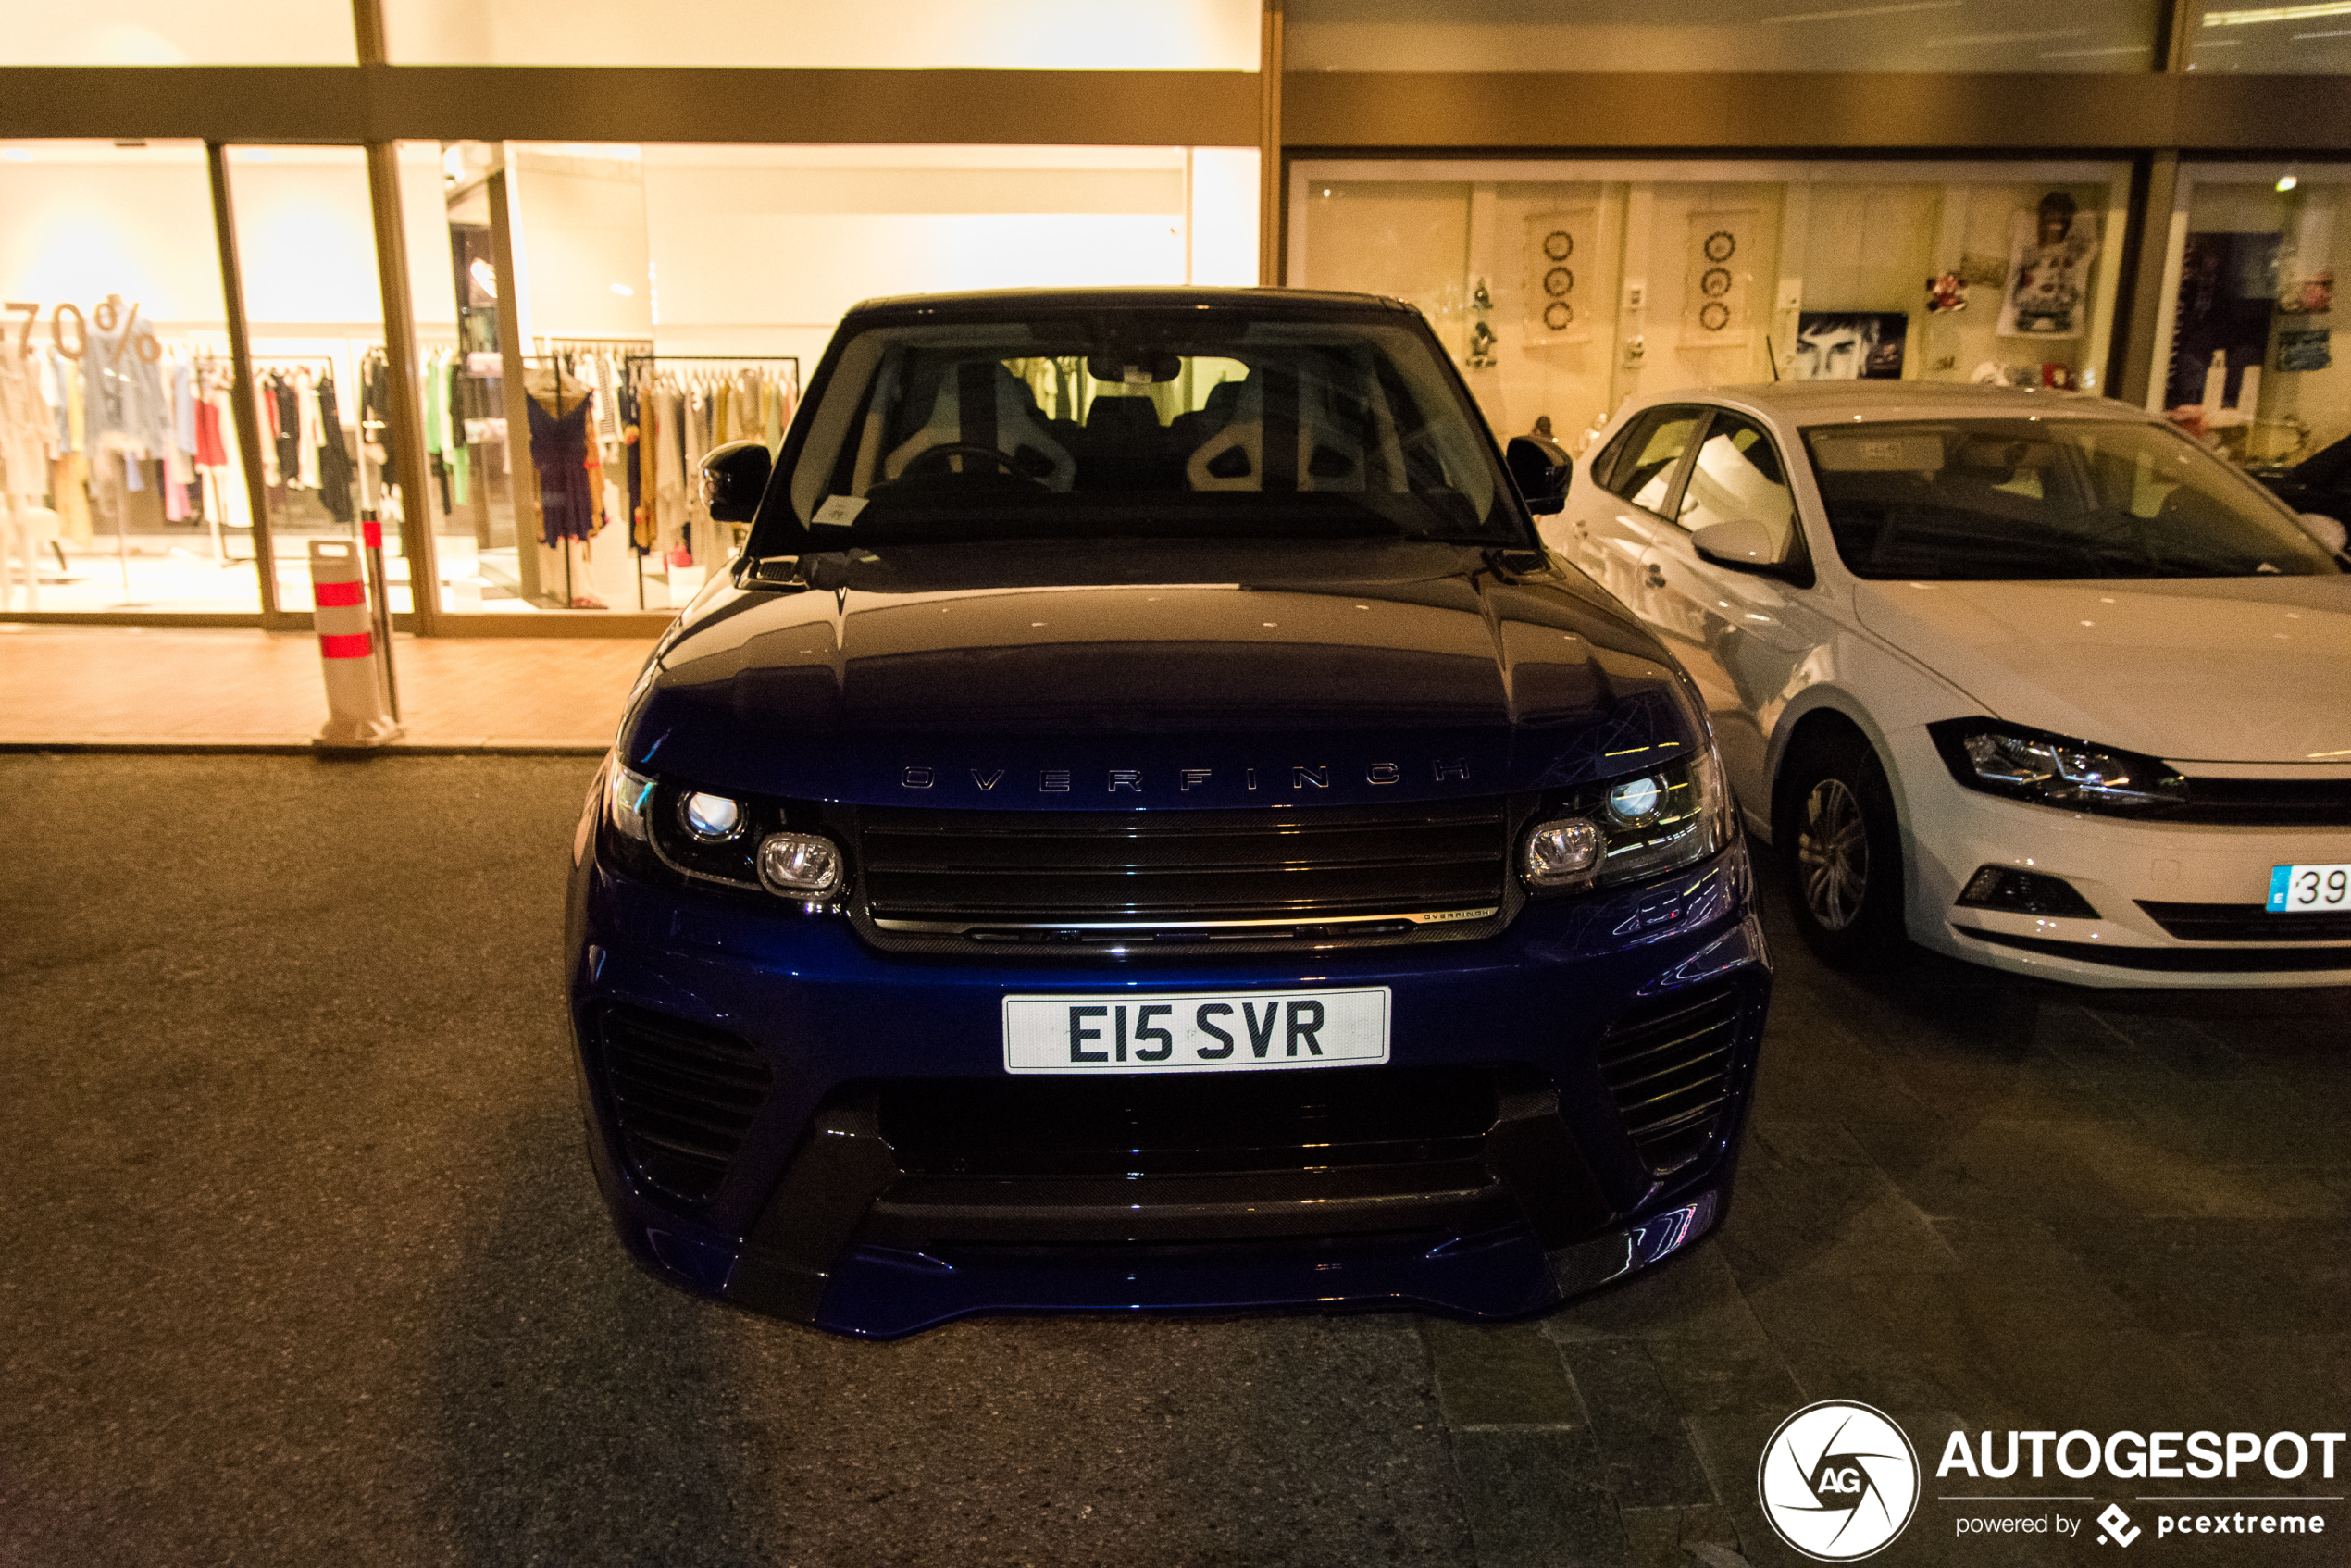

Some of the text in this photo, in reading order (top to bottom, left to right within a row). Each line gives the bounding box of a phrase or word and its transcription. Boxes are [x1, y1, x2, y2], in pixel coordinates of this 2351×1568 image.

[901, 758, 1470, 792] OVERFINCH
[1424, 910, 1490, 920] OVERFINCH
[1196, 1000, 1325, 1060] SVR
